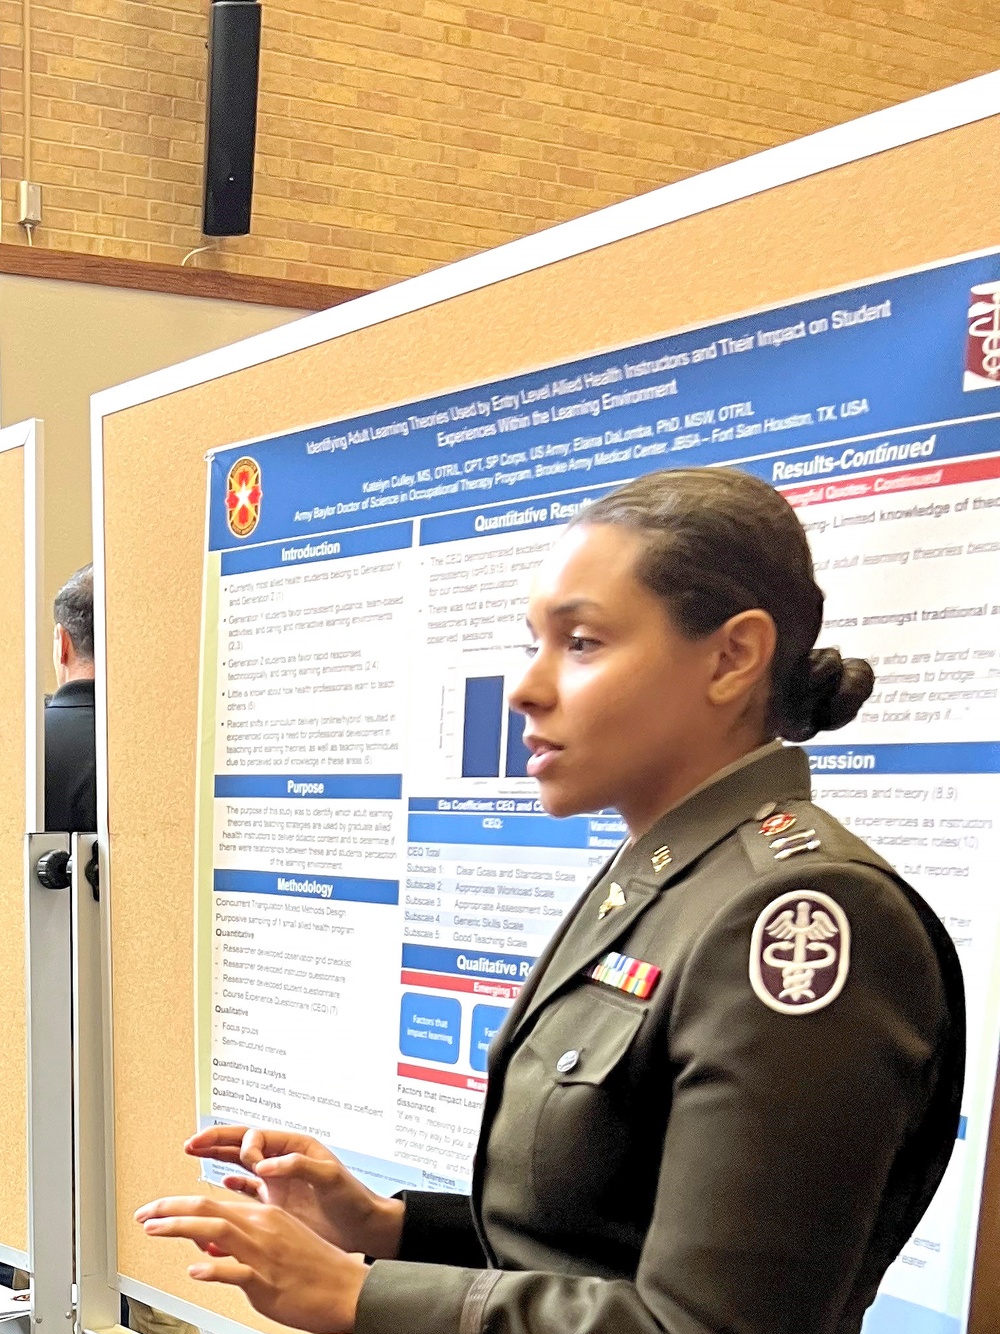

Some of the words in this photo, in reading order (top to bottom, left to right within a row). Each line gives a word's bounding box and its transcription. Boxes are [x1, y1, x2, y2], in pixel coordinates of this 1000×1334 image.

[349, 428, 369, 445] Adult
[370, 417, 408, 441] Learning
[407, 408, 449, 432] Theories
[451, 402, 474, 421] Used
[475, 401, 490, 417] by
[492, 395, 519, 411] Entry
[521, 384, 549, 404] Level
[552, 376, 582, 397] Allied
[584, 367, 623, 388] Health
[625, 352, 690, 379] Instructors
[692, 342, 716, 363] and
[720, 334, 754, 355] Their
[757, 321, 805, 347] Impact
[809, 318, 828, 335] on
[832, 300, 892, 329] Student
[436, 424, 496, 447] Experiences
[498, 414, 529, 433] Within
[532, 410, 549, 426] the
[551, 399, 599, 421] Learning
[602, 379, 678, 410] Environment
[294, 511, 312, 522] Army
[313, 506, 335, 519] Baylor
[337, 502, 360, 514] Doctor
[361, 497, 370, 510] of
[371, 492, 398, 508] Science
[400, 491, 407, 502] in
[409, 480, 459, 501] Occupational
[460, 477, 492, 491] Therapy
[568, 457, 592, 471] Army
[594, 447, 631, 466] Medical
[712, 427, 733, 443] Fort
[736, 423, 761, 438] Sam
[841, 398, 869, 417] USA
[773, 435, 936, 481] Results-Continued
[879, 502, 949, 521] knowledge
[954, 497, 969, 512] of
[474, 506, 547, 532] Quantitative
[281, 541, 340, 561] Introduction
[921, 603, 987, 621] traditional
[934, 648, 969, 662] brand
[809, 751, 876, 770] cussion
[287, 780, 323, 796] Purpose
[871, 786, 892, 799] and
[894, 786, 929, 802] theory
[226, 805, 238, 814] The
[240, 807, 261, 815] purpose
[495, 800, 514, 811] CEQ
[516, 800, 531, 811] and
[406, 862, 436, 874] Subscale
[456, 865, 475, 876] Clear
[476, 866, 497, 877] Goals
[499, 869, 513, 878] and
[554, 870, 575, 882] Scale
[277, 878, 332, 898] Methodology
[406, 878, 434, 890] Subscale
[455, 883, 494, 895] Appropriate
[534, 887, 554, 899] Scale
[405, 895, 434, 906] Subscale
[454, 899, 493, 911] Appropriate
[495, 902, 540, 914] Assessment
[542, 905, 563, 917] Scale
[404, 911, 433, 923] Subscale
[453, 915, 480, 927] Generic
[482, 917, 500, 929] Skills
[503, 919, 523, 931] Scale
[404, 926, 432, 939] Subscale
[453, 931, 471, 943] Good
[473, 933, 504, 949] Teaching
[506, 937, 527, 948] Scale
[456, 955, 516, 976] Qualitative
[473, 982, 510, 999] Emerging
[222, 1021, 240, 1032] Focus
[413, 1014, 433, 1026] Factors
[435, 1019, 448, 1028] that
[407, 1028, 427, 1038] impact
[428, 1031, 452, 1045] learning
[213, 1058, 249, 1071] Quantitative
[250, 1064, 262, 1074] Data
[263, 1068, 286, 1080] Analysis
[213, 1087, 244, 1100] Qualitative
[245, 1093, 257, 1103] Data
[258, 1097, 281, 1109] Analysis
[397, 1084, 421, 1097] Factors
[424, 1091, 436, 1100] that
[438, 1095, 461, 1105] impact
[422, 1170, 455, 1186] References
